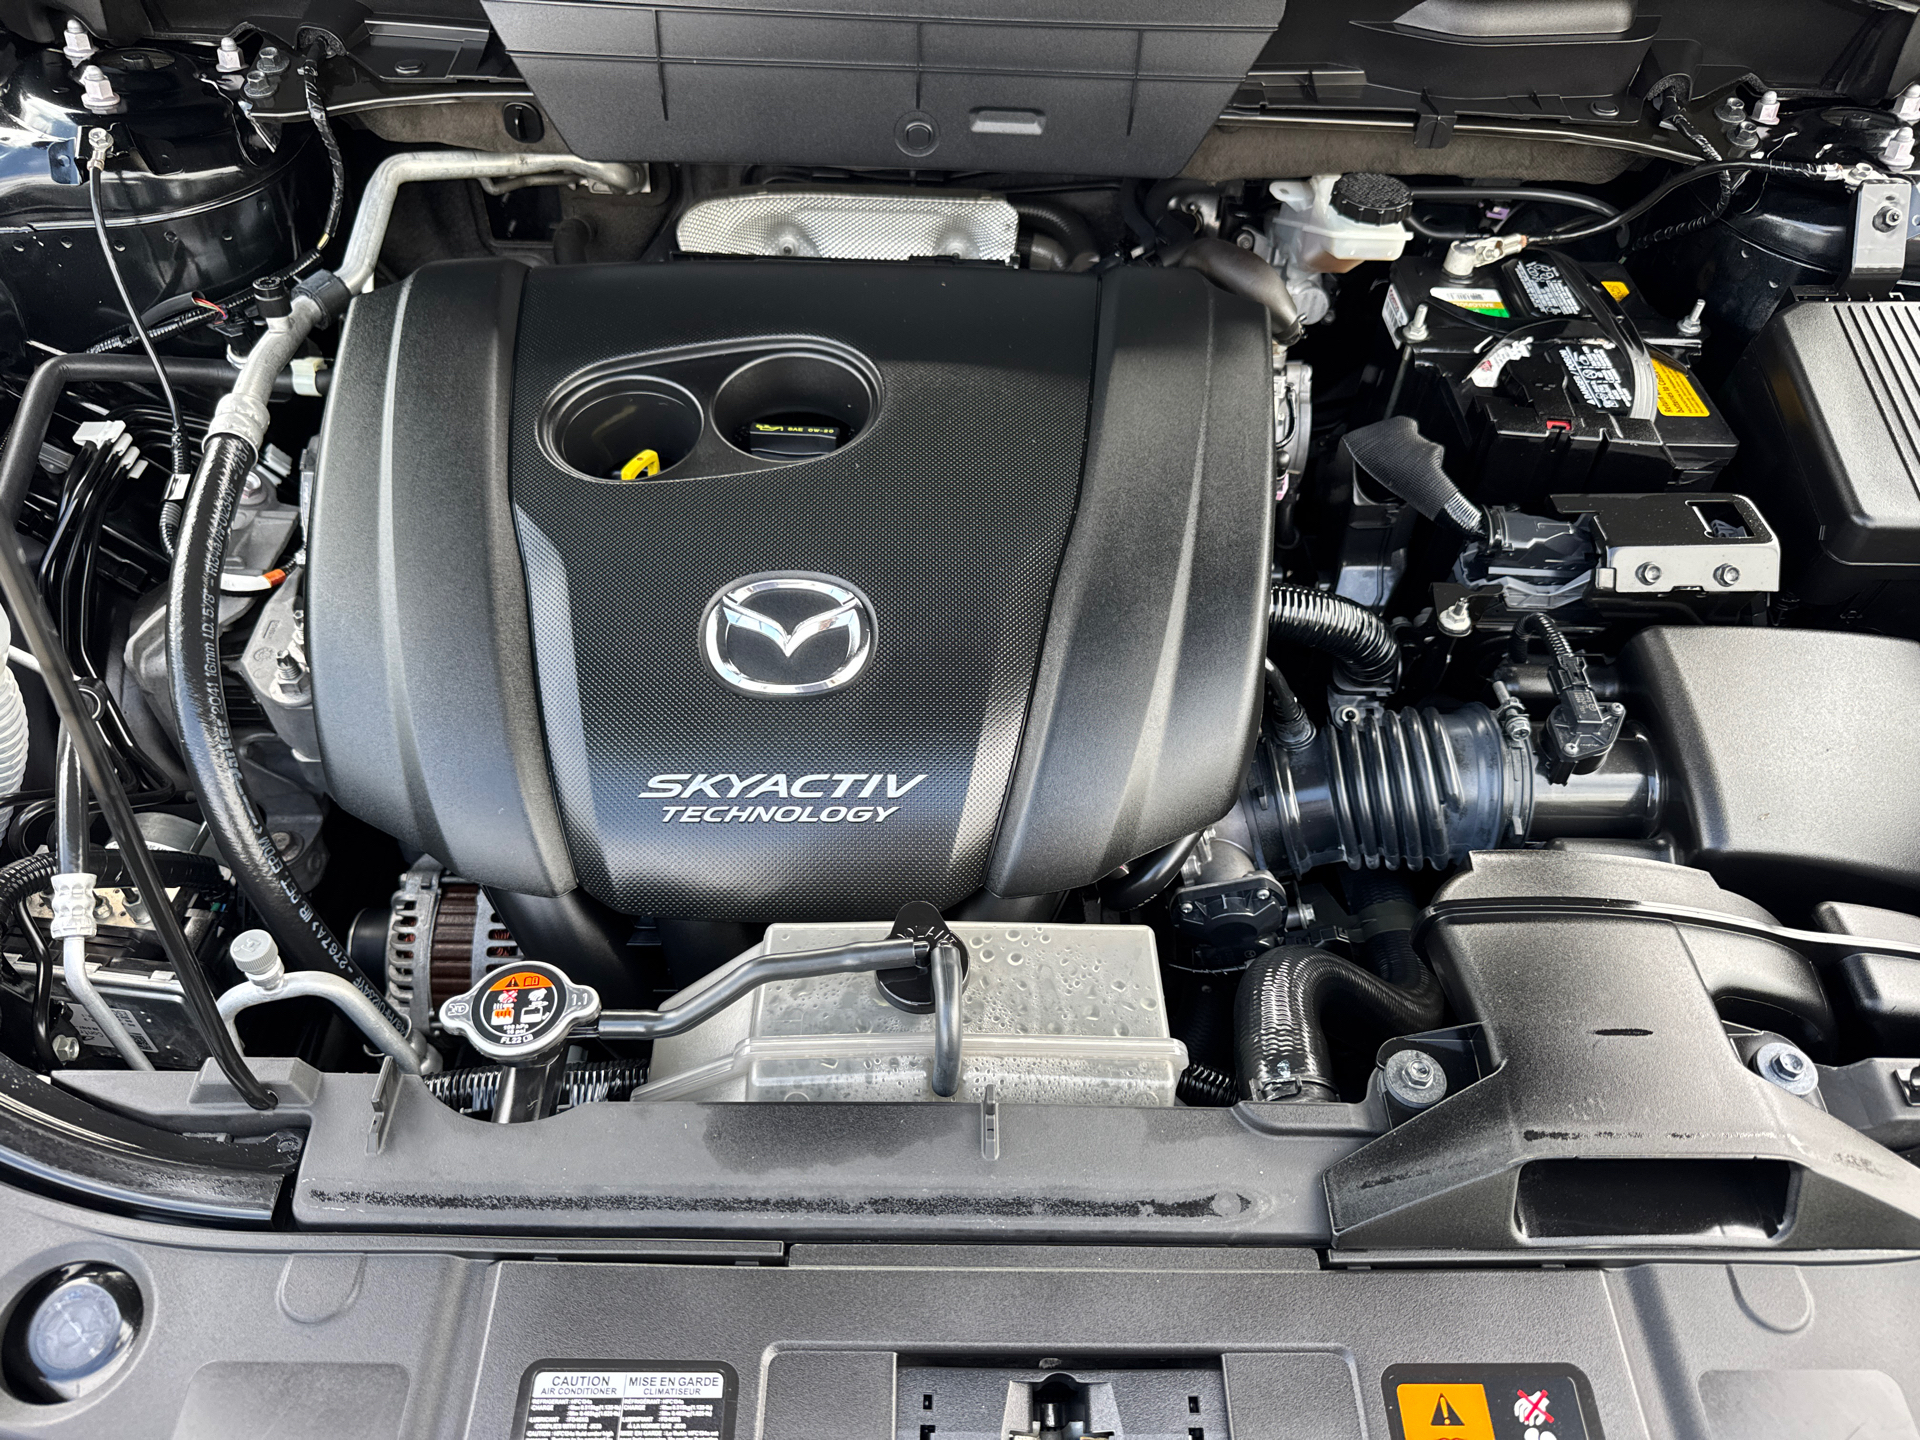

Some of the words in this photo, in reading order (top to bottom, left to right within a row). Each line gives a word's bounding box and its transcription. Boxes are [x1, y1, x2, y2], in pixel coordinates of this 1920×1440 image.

[204, 642, 217, 677] 16mm
[207, 683, 224, 715] 2041
[638, 774, 929, 799] SKYACTIV
[662, 806, 902, 823] TECHNOLOGY
[571, 993, 588, 1006] 1.1
[552, 1376, 610, 1387] CAUTION
[629, 1377, 657, 1387] MISE
[660, 1377, 676, 1387] EN
[678, 1377, 719, 1387] GARDE
[643, 1388, 701, 1396] CLIMATISEUR
